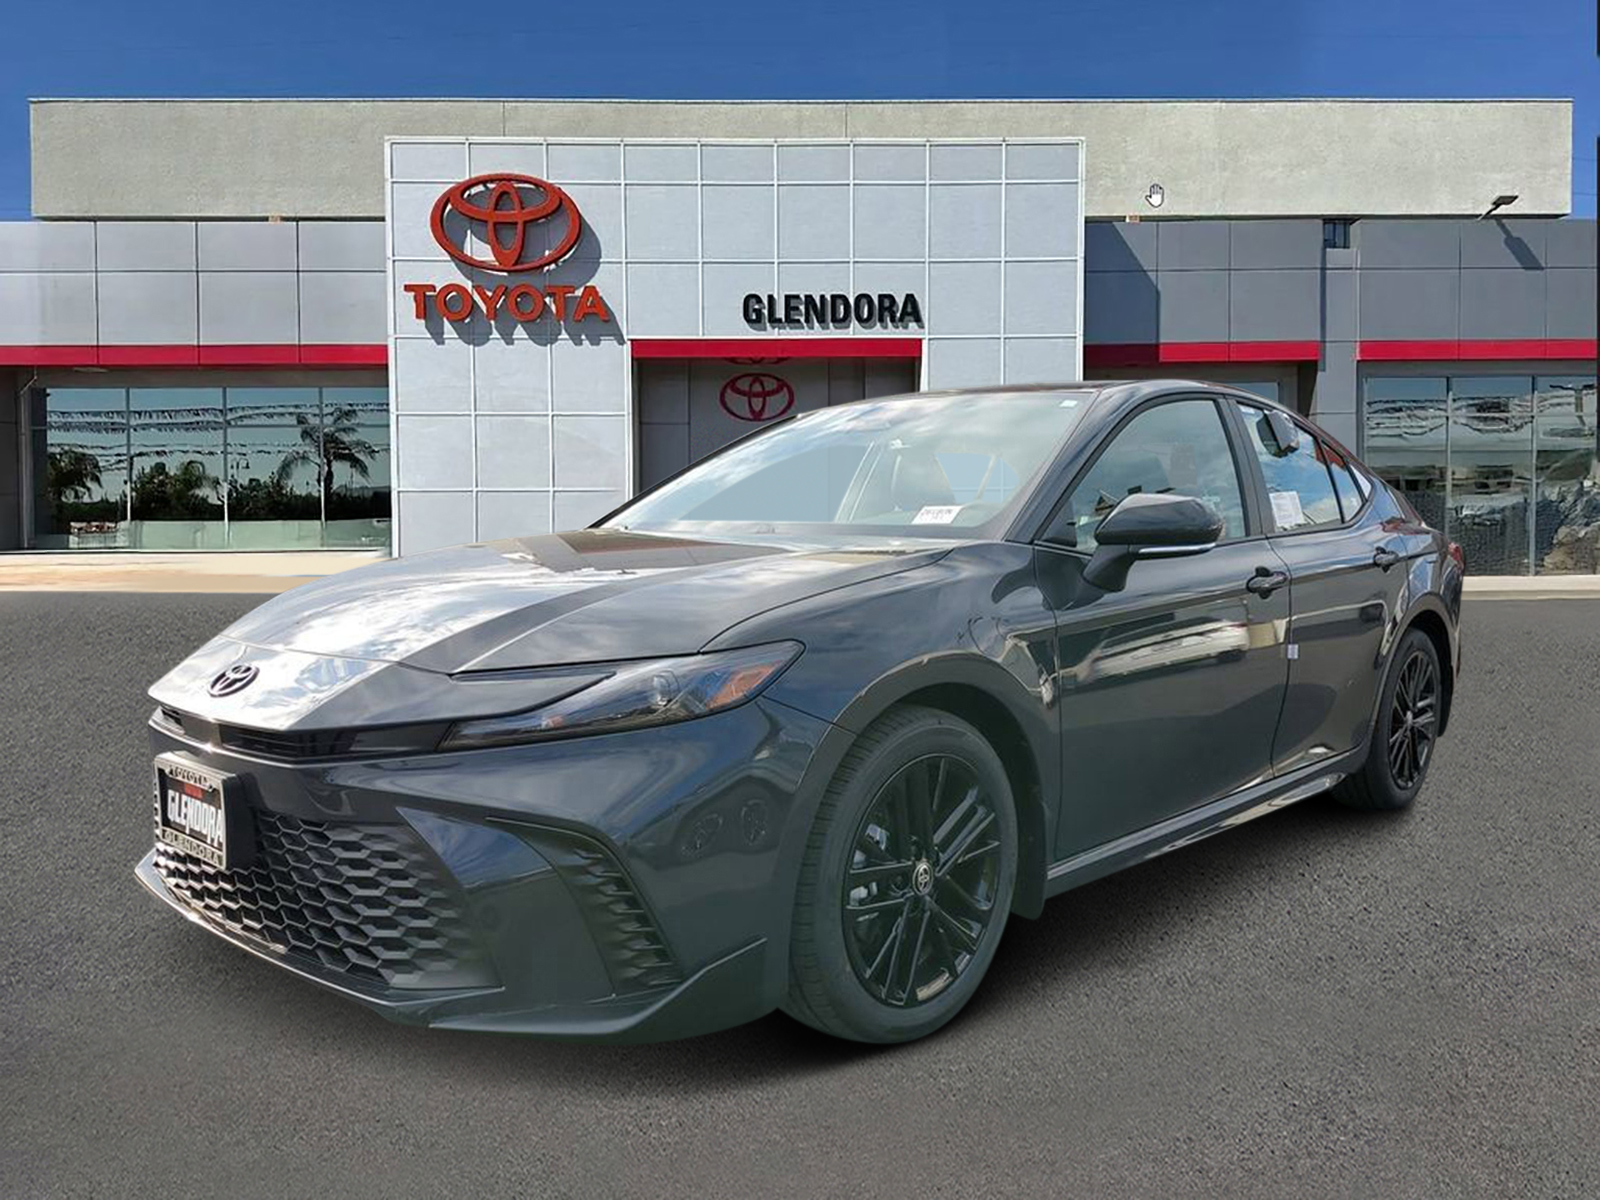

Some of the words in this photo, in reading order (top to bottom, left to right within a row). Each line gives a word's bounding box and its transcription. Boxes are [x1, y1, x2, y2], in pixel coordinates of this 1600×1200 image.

[403, 283, 611, 323] TOYOTA
[742, 293, 923, 326] GLENDORA
[166, 789, 223, 847] GLENDORA
[164, 831, 220, 865] GLENDORA
